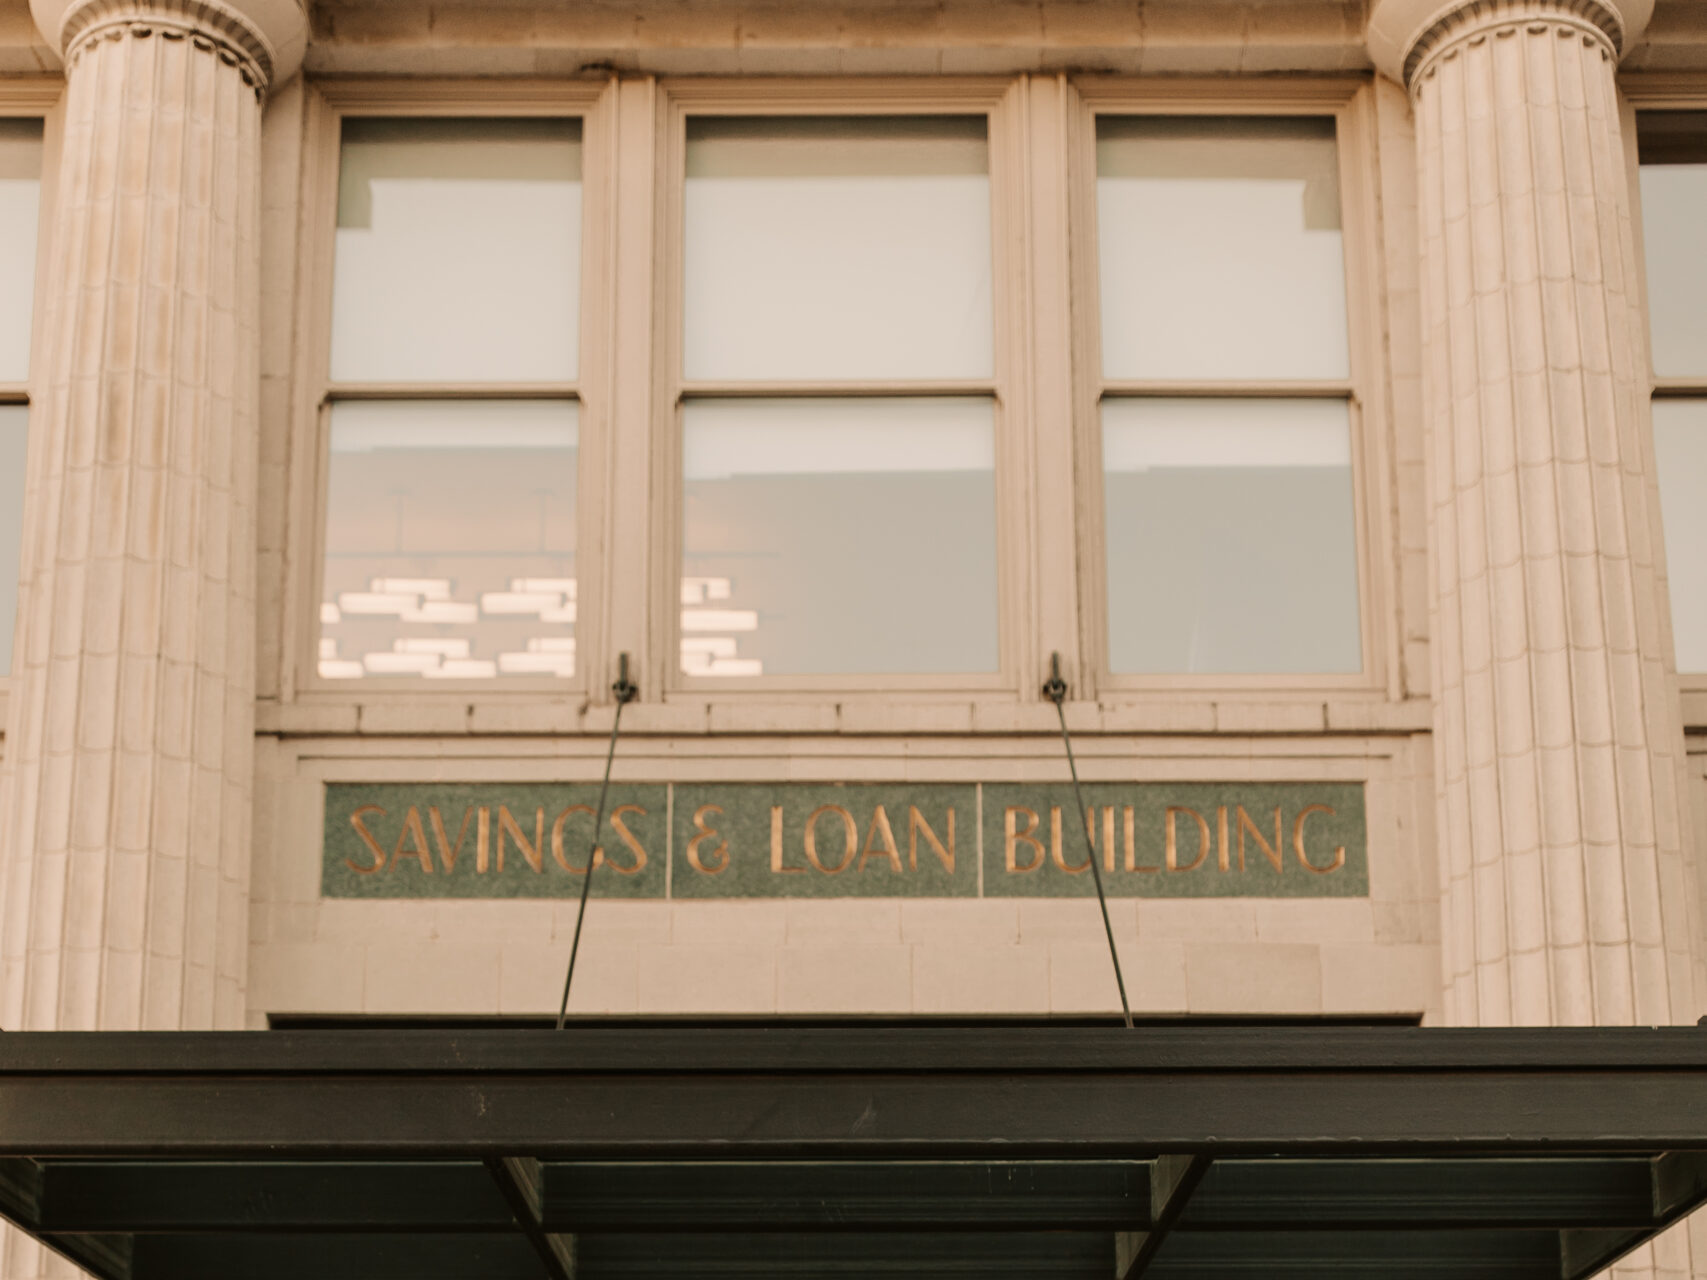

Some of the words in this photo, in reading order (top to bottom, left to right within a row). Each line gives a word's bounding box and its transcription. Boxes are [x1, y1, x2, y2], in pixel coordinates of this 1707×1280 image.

[345, 804, 647, 875] SAVINGS
[686, 804, 730, 876] &
[770, 804, 956, 875] LOAN
[1005, 804, 1345, 875] BUILDING
